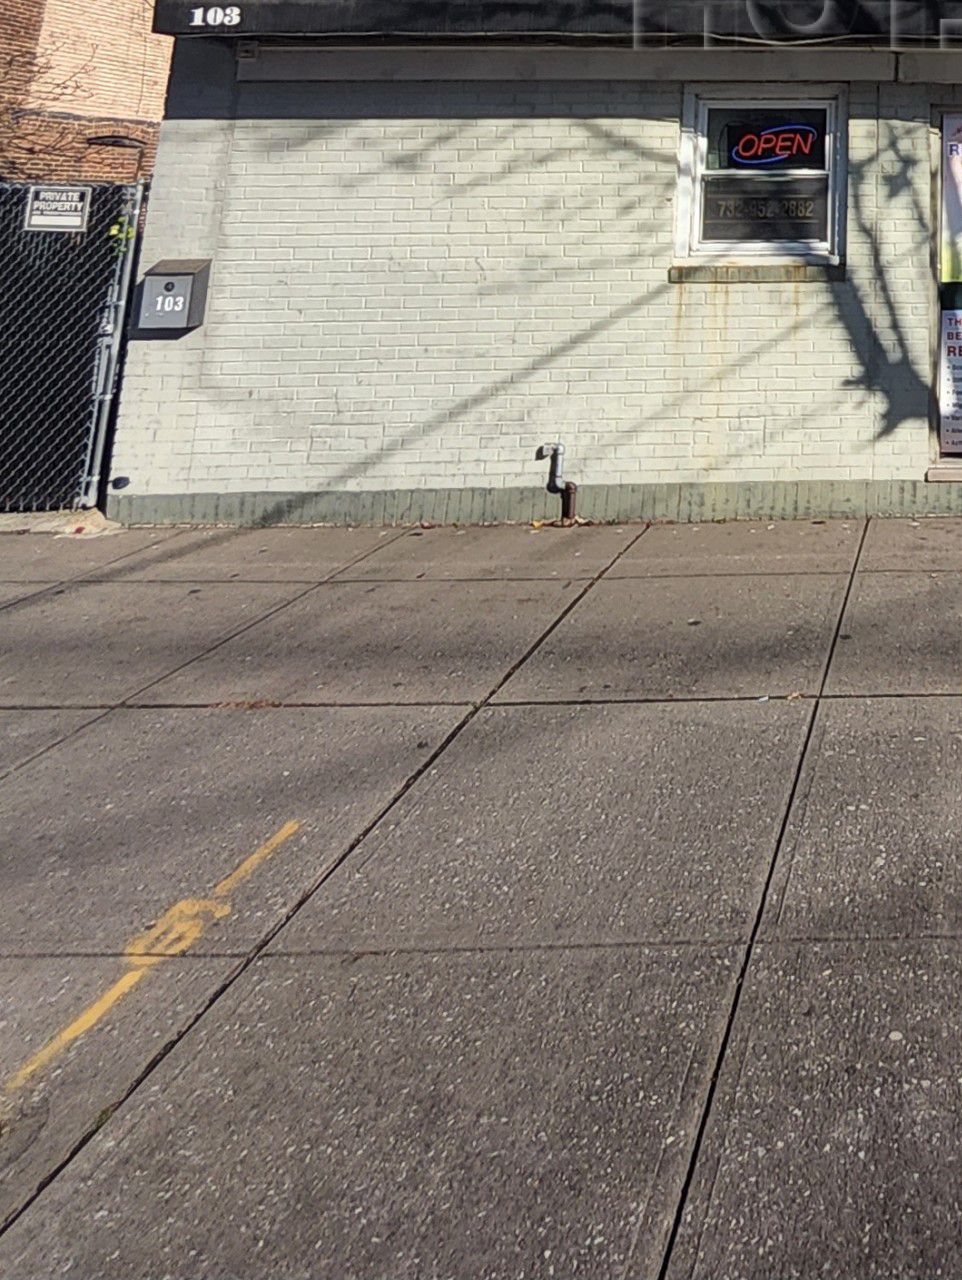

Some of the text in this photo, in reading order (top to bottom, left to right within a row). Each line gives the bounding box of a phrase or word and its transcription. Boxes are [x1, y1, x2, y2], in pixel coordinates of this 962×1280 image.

[188, 6, 242, 27] 103
[739, 133, 813, 157] OPEN
[40, 191, 80, 201] PRIVATE
[33, 201, 83, 211] PROPERTY
[155, 295, 185, 311] 103
